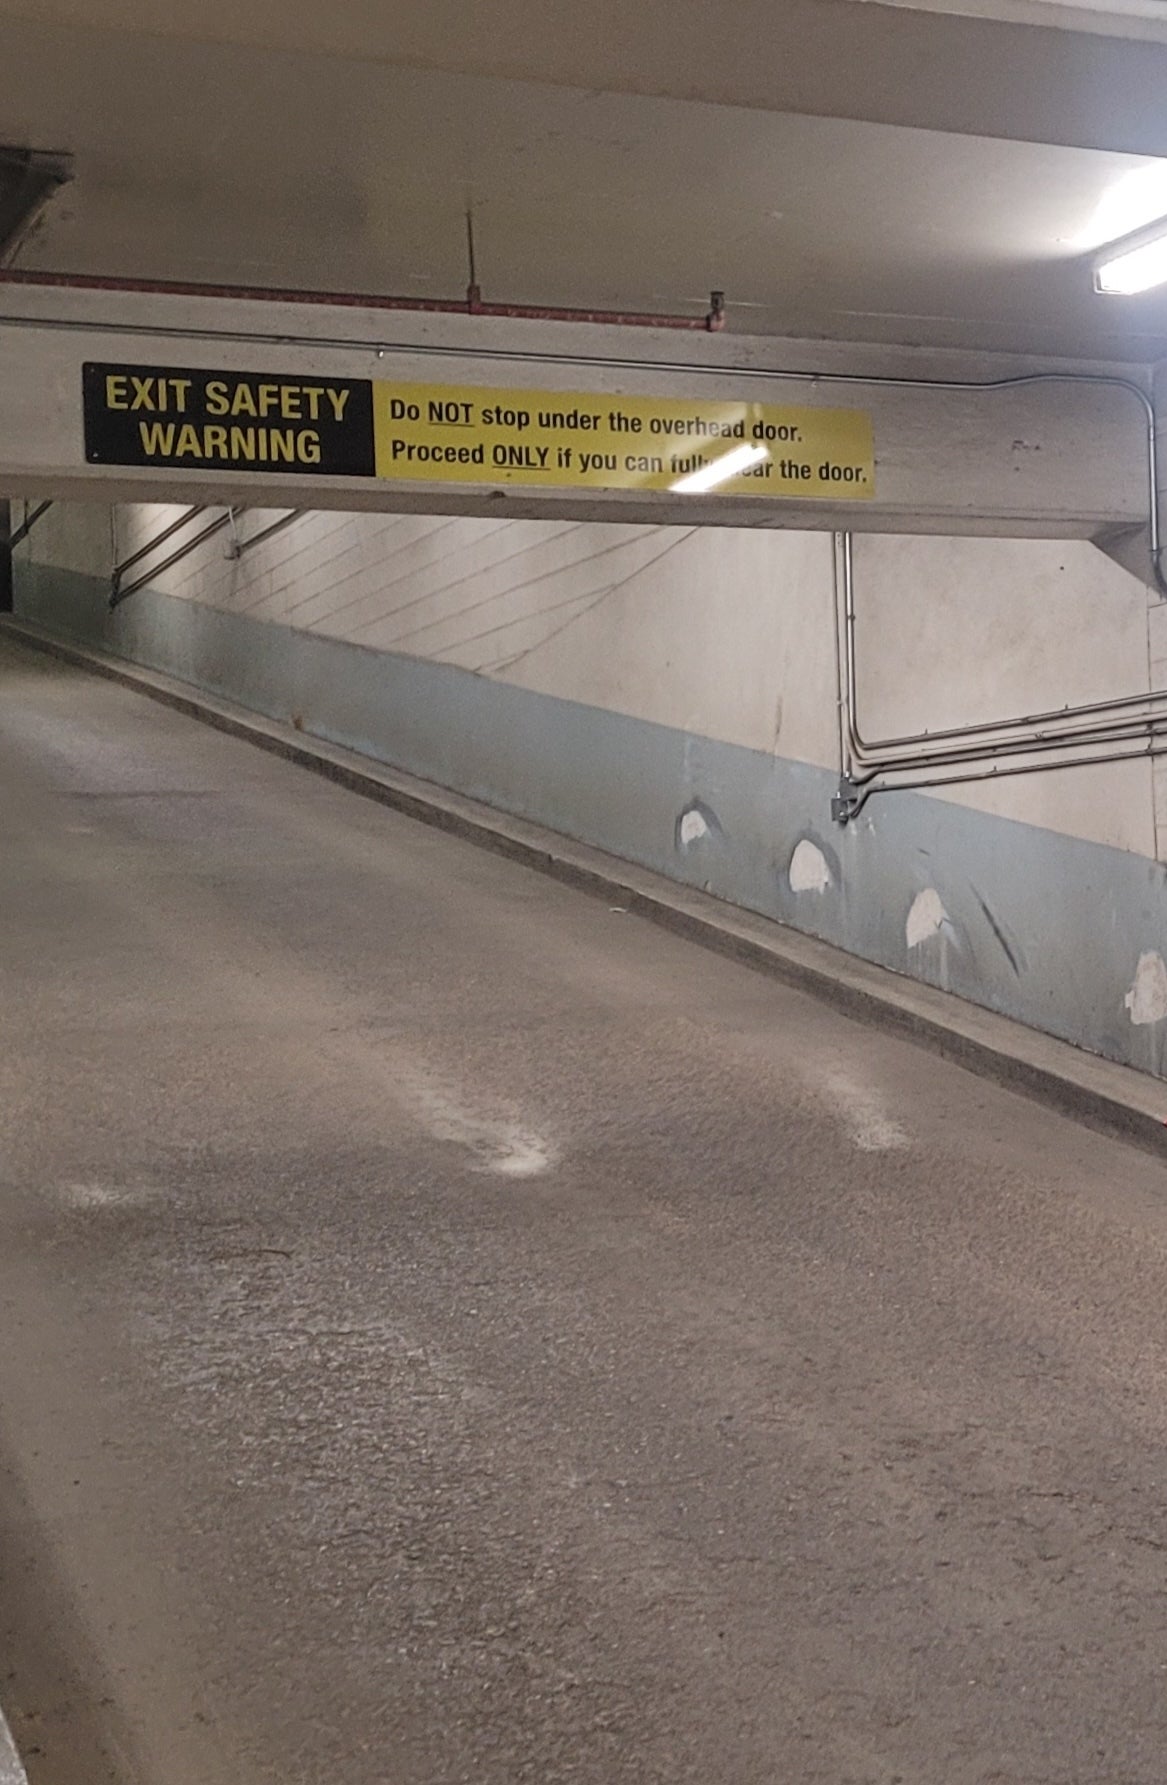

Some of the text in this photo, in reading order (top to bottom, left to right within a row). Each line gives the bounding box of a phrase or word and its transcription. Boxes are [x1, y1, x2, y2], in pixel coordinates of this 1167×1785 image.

[105, 375, 350, 421] EXIT SAFETY
[139, 421, 321, 463] WARNING
[391, 399, 802, 442] Do NOT stop under the overhead door.
[392, 440, 484, 464] Proceed
[492, 445, 550, 470] ONLY
[557, 447, 572, 468] if
[579, 453, 616, 473] you
[625, 455, 663, 473] can
[671, 454, 713, 475] full
[780, 460, 811, 480] the
[818, 462, 867, 483] door.
